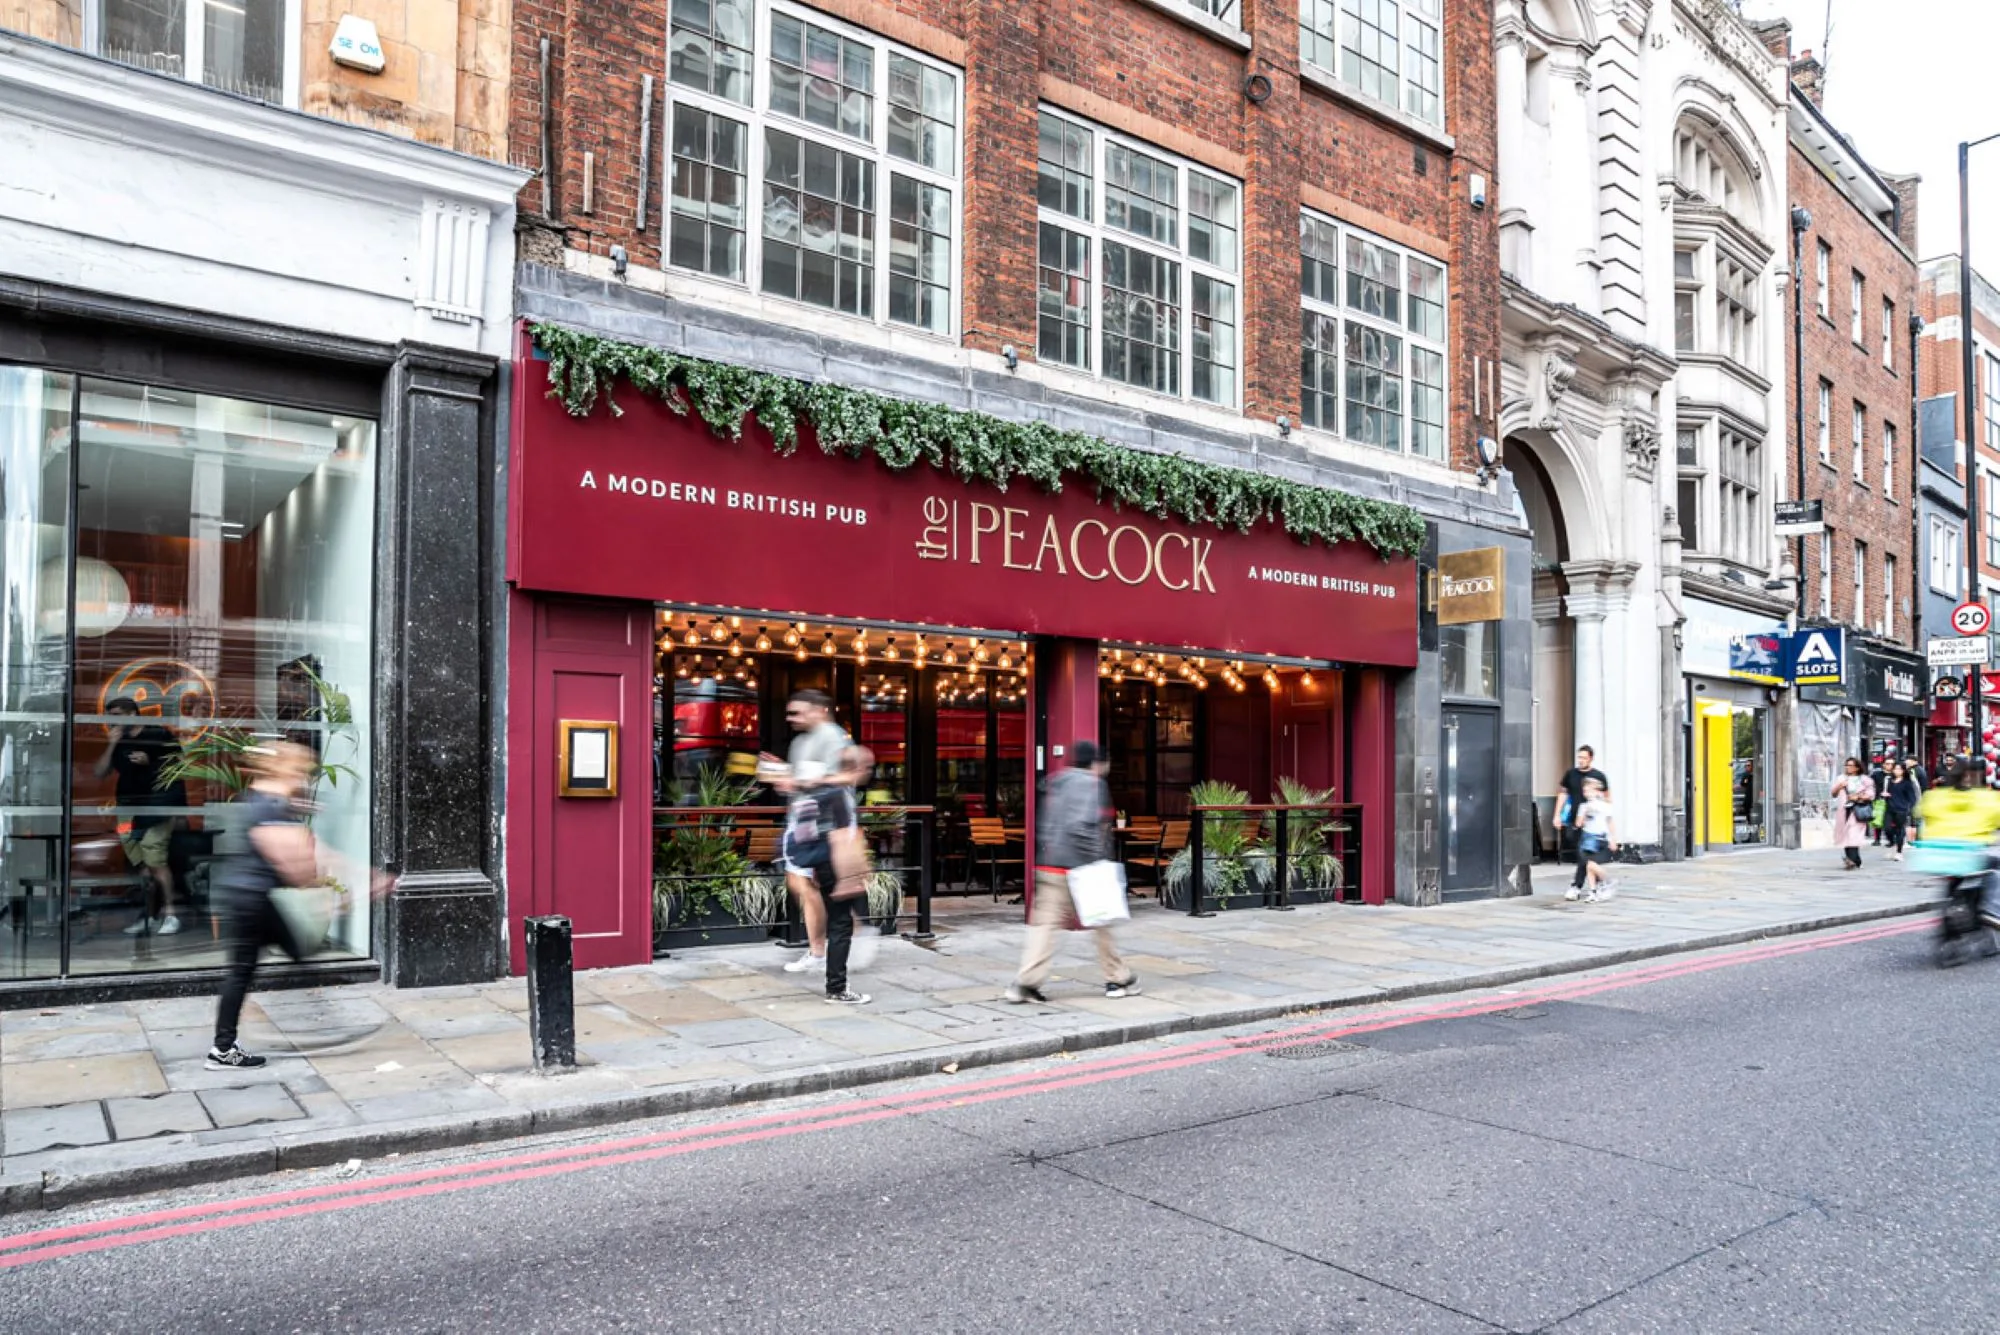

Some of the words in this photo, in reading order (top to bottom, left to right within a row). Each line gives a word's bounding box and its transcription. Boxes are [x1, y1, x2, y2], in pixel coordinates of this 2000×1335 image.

[580, 471, 596, 489] A
[608, 473, 716, 505] MODERN
[727, 490, 816, 519] BRITISH
[825, 504, 867, 526] PUB
[915, 496, 949, 559] the
[970, 502, 1217, 594] PEACOCK
[1248, 566, 1258, 580] A
[1262, 567, 1317, 588] MODERN
[1322, 575, 1369, 595] BRITISH
[1373, 584, 1396, 599] PUB
[1440, 577, 1496, 597] PEACOCK
[1958, 611, 1985, 626] 20
[1797, 632, 1837, 663] A
[1940, 640, 1974, 648] POLICE
[1796, 663, 1838, 675] SLOTS
